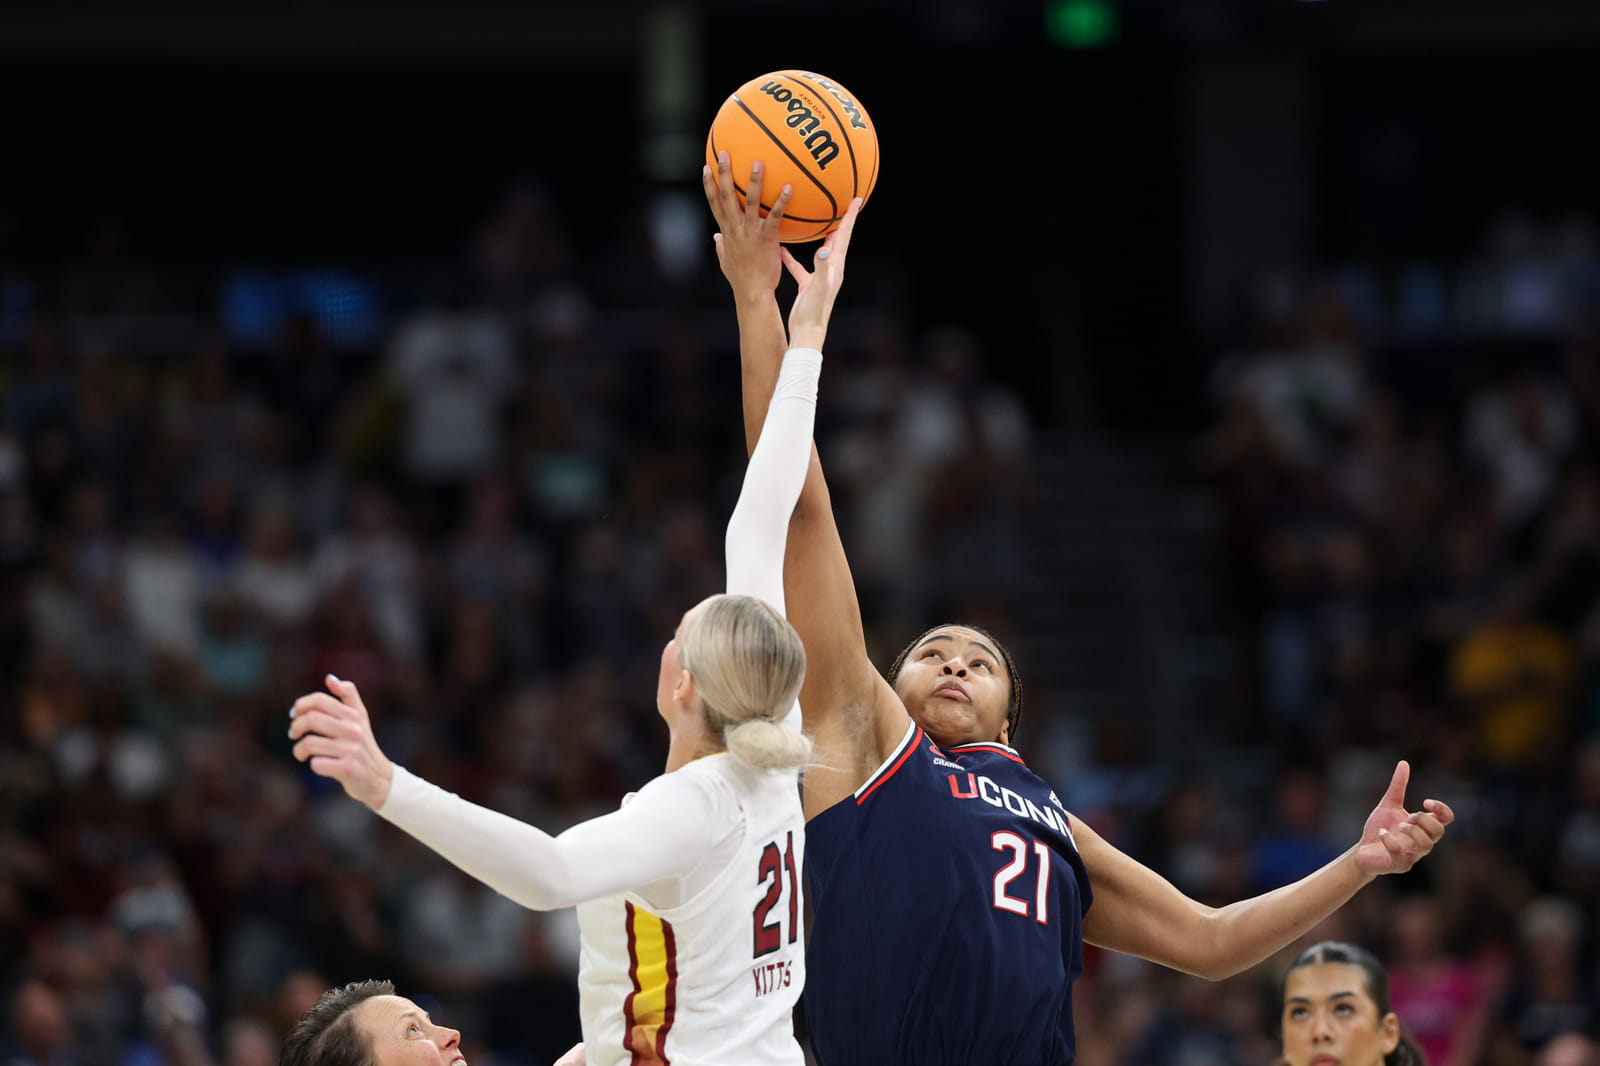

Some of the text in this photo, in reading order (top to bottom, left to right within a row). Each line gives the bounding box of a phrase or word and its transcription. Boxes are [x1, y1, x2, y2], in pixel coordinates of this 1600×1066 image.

[759, 79, 840, 171] Wilson
[948, 773, 1079, 853] UCONN
[752, 830, 798, 960] 21
[991, 830, 1049, 926] 21
[753, 960, 792, 997] KITTS
